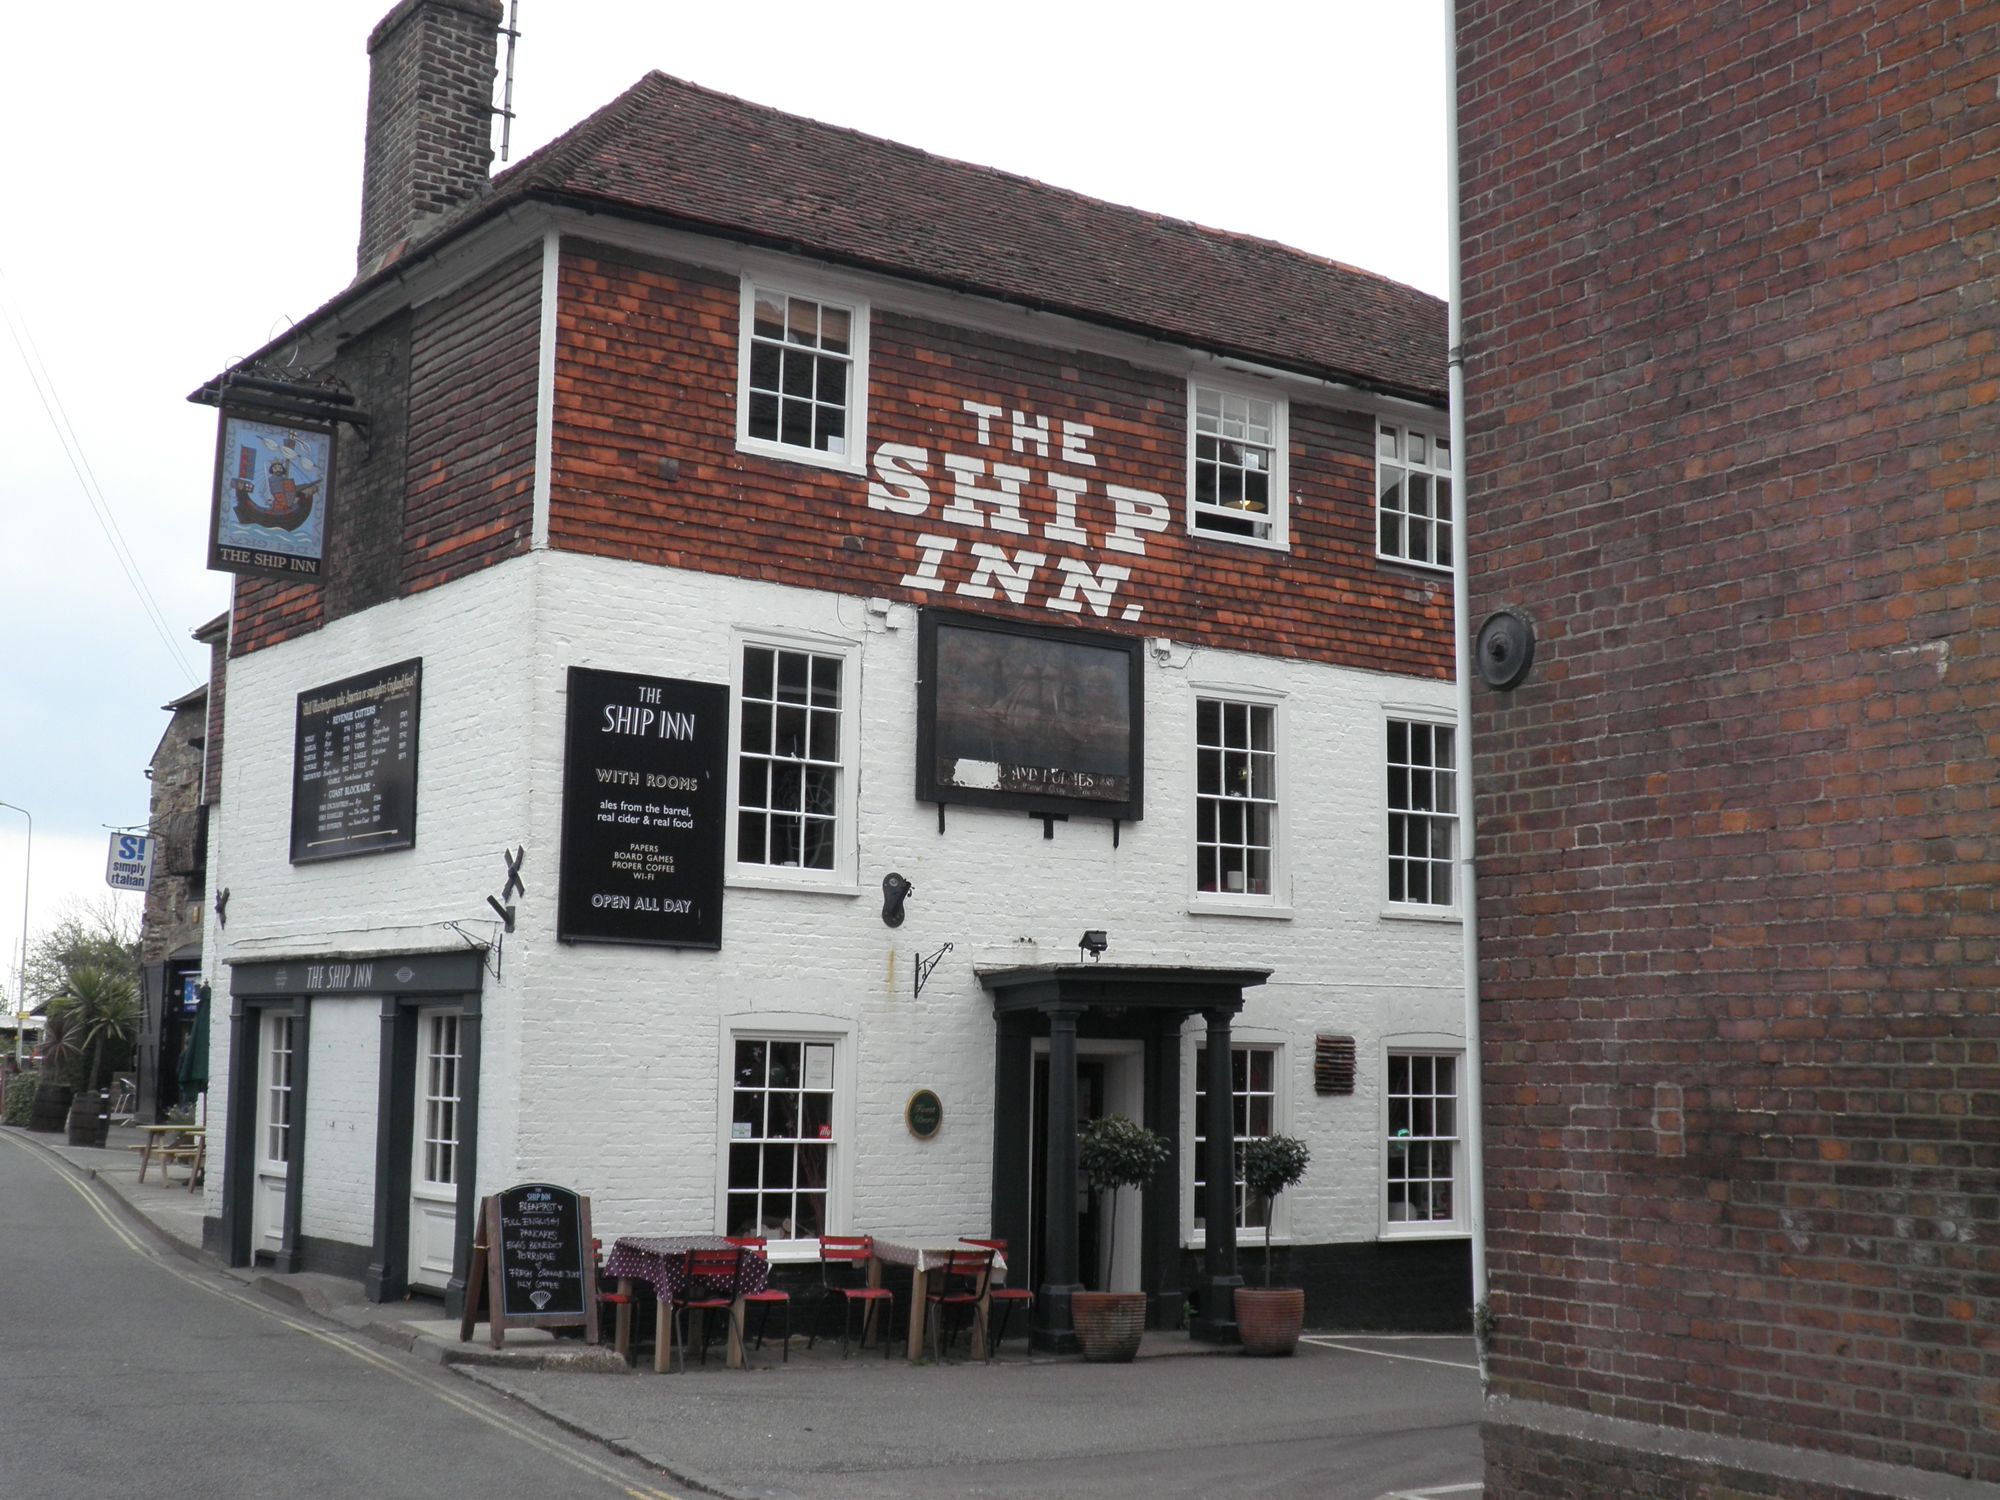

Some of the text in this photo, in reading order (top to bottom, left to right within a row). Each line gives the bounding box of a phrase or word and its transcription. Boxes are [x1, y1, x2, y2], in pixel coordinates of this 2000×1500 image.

[963, 400, 1096, 466] THE
[868, 442, 1170, 555] SHIP
[220, 548, 317, 573] THE SHIP INN
[638, 686, 662, 704] THE
[601, 704, 695, 742] SHIP INN
[595, 768, 698, 791] WITH ROOMS
[328, 782, 370, 799] COAST BLOCKADE
[599, 800, 691, 817] ales from the barrel,
[597, 812, 693, 829] real cider & real food
[119, 836, 145, 861] S!
[630, 843, 659, 853] PAPERS
[614, 852, 674, 864] BOARD GAMES
[113, 862, 146, 876] simply
[612, 861, 675, 873] PROPER COFFEE
[633, 872, 655, 881] WI-FI
[591, 894, 692, 914] OPEN ALL DAY
[306, 964, 373, 989] THE SHIP INN
[501, 1217, 560, 1226] FULL ENGLISH
[520, 1229, 558, 1240] PANCAKES
